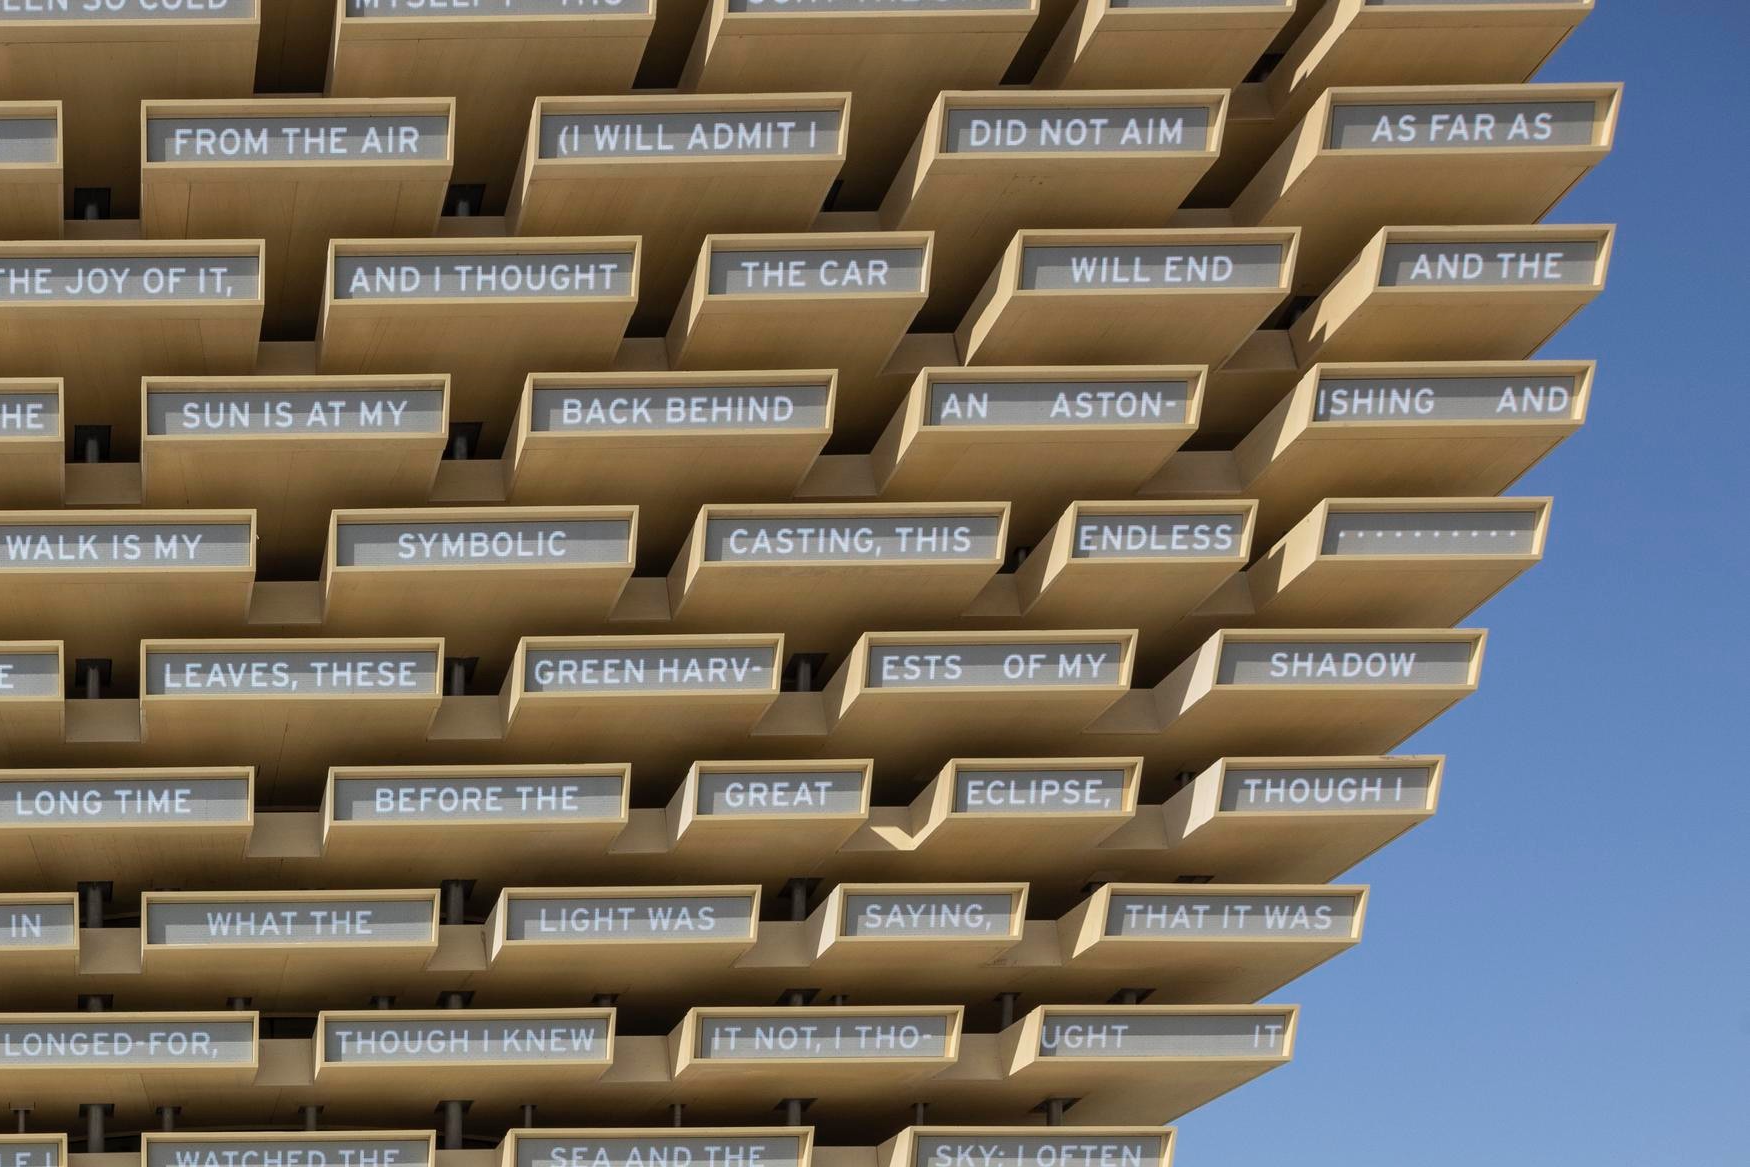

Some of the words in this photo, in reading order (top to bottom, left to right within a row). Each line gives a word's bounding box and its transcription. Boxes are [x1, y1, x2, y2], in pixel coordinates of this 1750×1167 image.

[175, 128, 268, 155] FROM
[282, 127, 347, 154] THE
[360, 126, 419, 153] AIR
[559, 125, 579, 155] (I
[594, 124, 674, 151] WILL
[687, 122, 796, 150] ADMIT
[809, 122, 815, 148] I
[970, 120, 1027, 146] DID
[1040, 119, 1108, 146] NOT
[1120, 118, 1183, 145] AIM
[1371, 115, 1416, 142] AS
[1430, 114, 1495, 141] FAR
[1507, 113, 1552, 140] AS
[350, 266, 420, 292] AND
[434, 266, 440, 292] I
[454, 264, 617, 291] THOUGHT
[741, 261, 806, 287] THE
[819, 260, 889, 286] CAR
[1072, 257, 1151, 283] WILL
[1164, 256, 1233, 282] END
[1410, 253, 1483, 280] AND
[1497, 253, 1563, 279] THE
[65, 268, 130, 294] JOY
[143, 267, 186, 294] OF
[199, 267, 232, 297] IT,
[563, 398, 652, 425] BACK
[666, 396, 793, 423] BEHIND
[942, 393, 988, 419] AN
[1050, 392, 1176, 418] ASTON-
[1319, 388, 1434, 415] ISHING
[1496, 386, 1569, 413] AND
[182, 402, 249, 429] SUN
[264, 401, 293, 428] IS
[306, 401, 346, 427] AT
[360, 401, 407, 426] MY
[6, 535, 98, 560] WALK
[113, 535, 141, 560] IS
[155, 534, 202, 559] MY
[398, 531, 566, 559] SYMBOLIC
[729, 528, 881, 557] CASTING,
[895, 527, 971, 553] THIS
[1080, 524, 1232, 550] ENDLESS
[165, 662, 298, 691] LEAVES,
[310, 661, 416, 687] THESE
[535, 659, 644, 685] GREEN
[659, 658, 763, 683] HARV-
[883, 655, 962, 680] ESTS
[1003, 654, 1046, 679] OF
[1058, 654, 1106, 678] MY
[1270, 652, 1416, 677] SHADOW
[16, 790, 102, 815] LONG
[114, 789, 191, 814] TIME
[376, 787, 503, 813] BEFORE
[516, 786, 578, 811] THE
[725, 781, 832, 808] GREAT
[968, 779, 1111, 808] ECLIPSE,
[1244, 778, 1381, 803] THOUGH
[1395, 777, 1402, 801] I
[11, 914, 41, 937] IN
[207, 912, 298, 936] WHAT
[310, 911, 372, 935] THE
[540, 907, 635, 932] LIGHT
[648, 907, 715, 931] WAS
[865, 904, 991, 930] SAYING,
[1126, 905, 1210, 928] THAT
[1223, 905, 1252, 928] IT
[1265, 906, 1332, 930] WAS
[4, 1032, 217, 1058] LONGED-FOR,
[336, 1030, 468, 1054] THOUGH
[483, 1030, 488, 1052] I
[504, 1028, 594, 1052] KNEW
[714, 1027, 741, 1050] IT
[755, 1027, 820, 1053] NOT,
[835, 1026, 840, 1049] I
[855, 1026, 932, 1049] THO-
[1042, 1025, 1128, 1048] UGHT
[1254, 1025, 1282, 1048] IT
[1018, 1145, 1023, 1167] I
[1037, 1145, 1141, 1167] OFTEN
